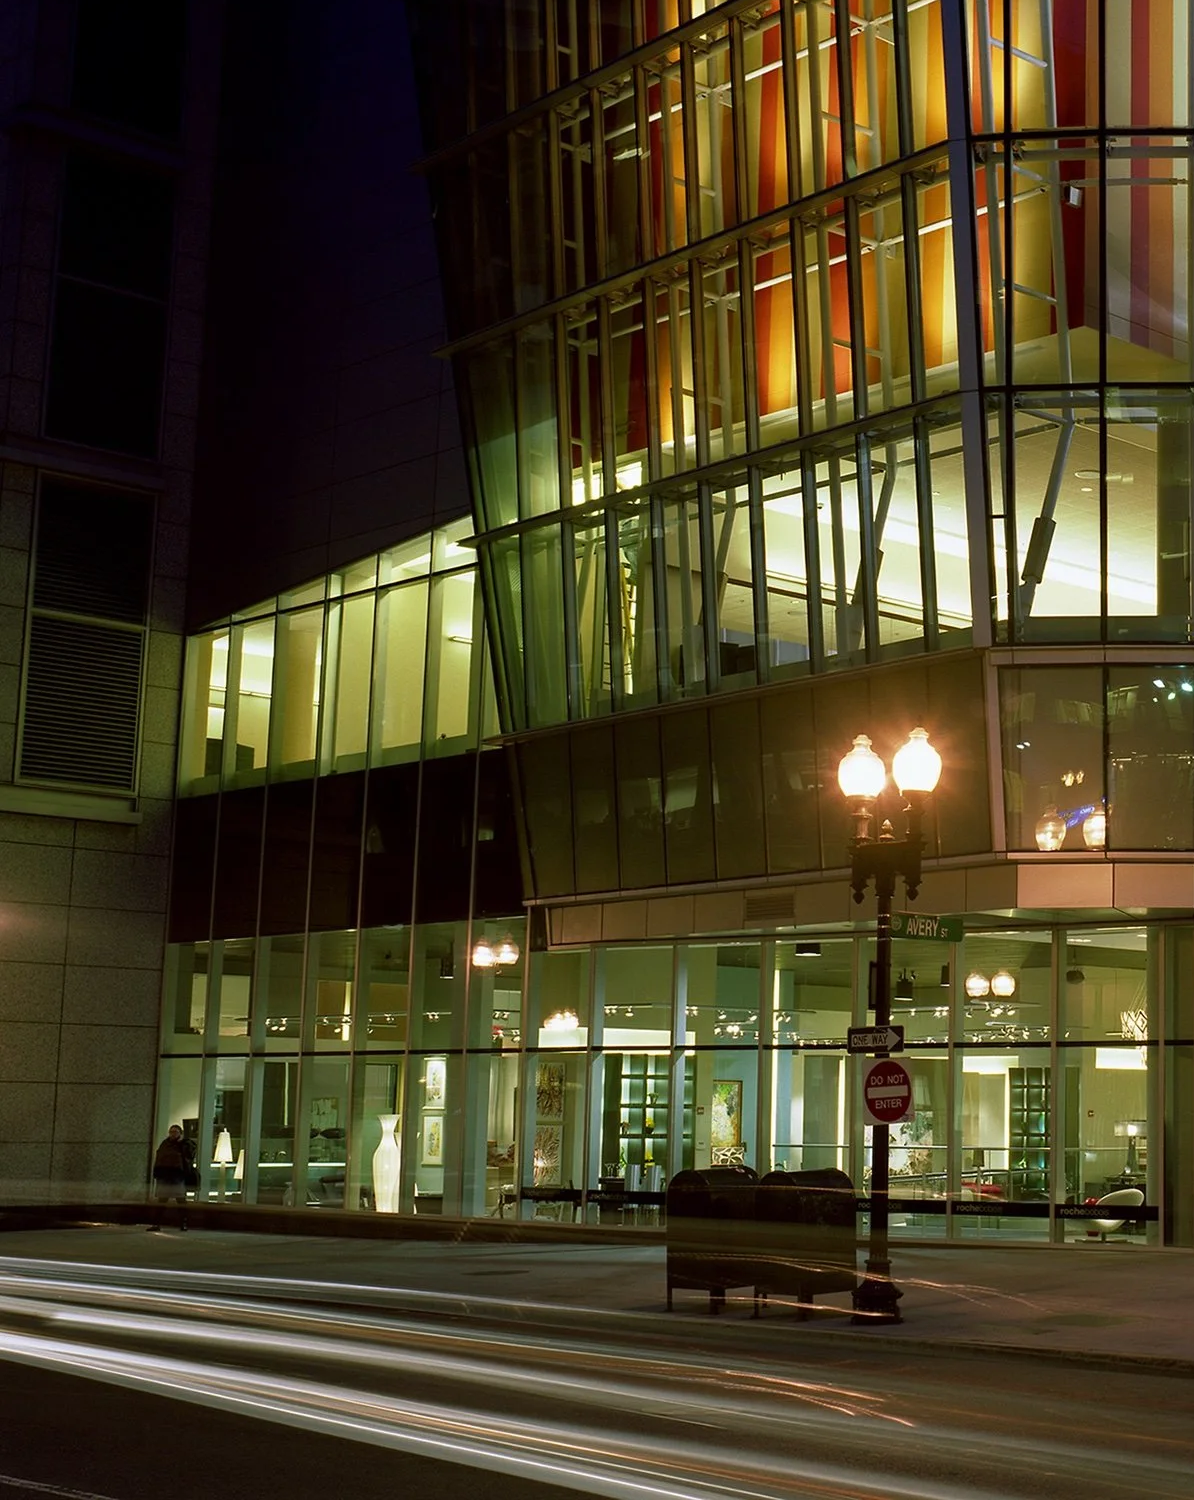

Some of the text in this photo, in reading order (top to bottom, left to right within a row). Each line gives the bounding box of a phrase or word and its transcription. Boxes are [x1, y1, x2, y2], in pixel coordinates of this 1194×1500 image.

[906, 917, 939, 937] AVERY
[852, 1034, 888, 1046] ONE WAY
[870, 1074, 905, 1085] DO NOT
[875, 1099, 902, 1110] ENTER
